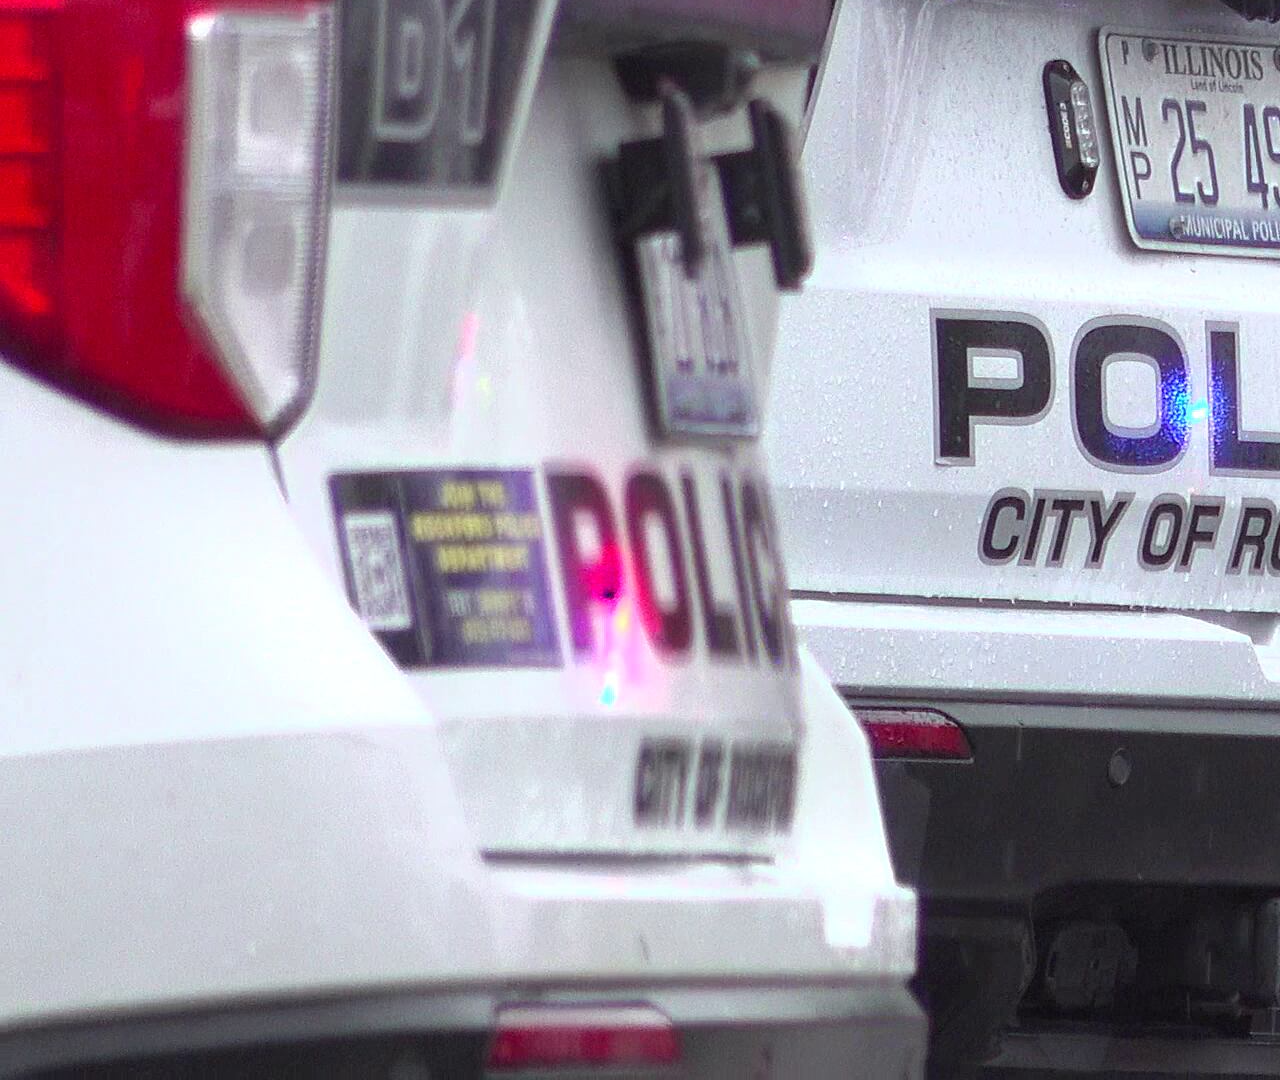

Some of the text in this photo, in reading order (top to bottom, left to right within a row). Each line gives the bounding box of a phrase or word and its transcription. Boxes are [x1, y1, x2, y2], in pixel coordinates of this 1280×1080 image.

[1161, 44, 1265, 82] ILLINOIS
[1161, 98, 1219, 205] 25
[1181, 216, 1250, 241] MUNICIPAL
[540, 465, 798, 668] POLIC
[977, 486, 1136, 570] CITY
[1137, 492, 1226, 575] OF
